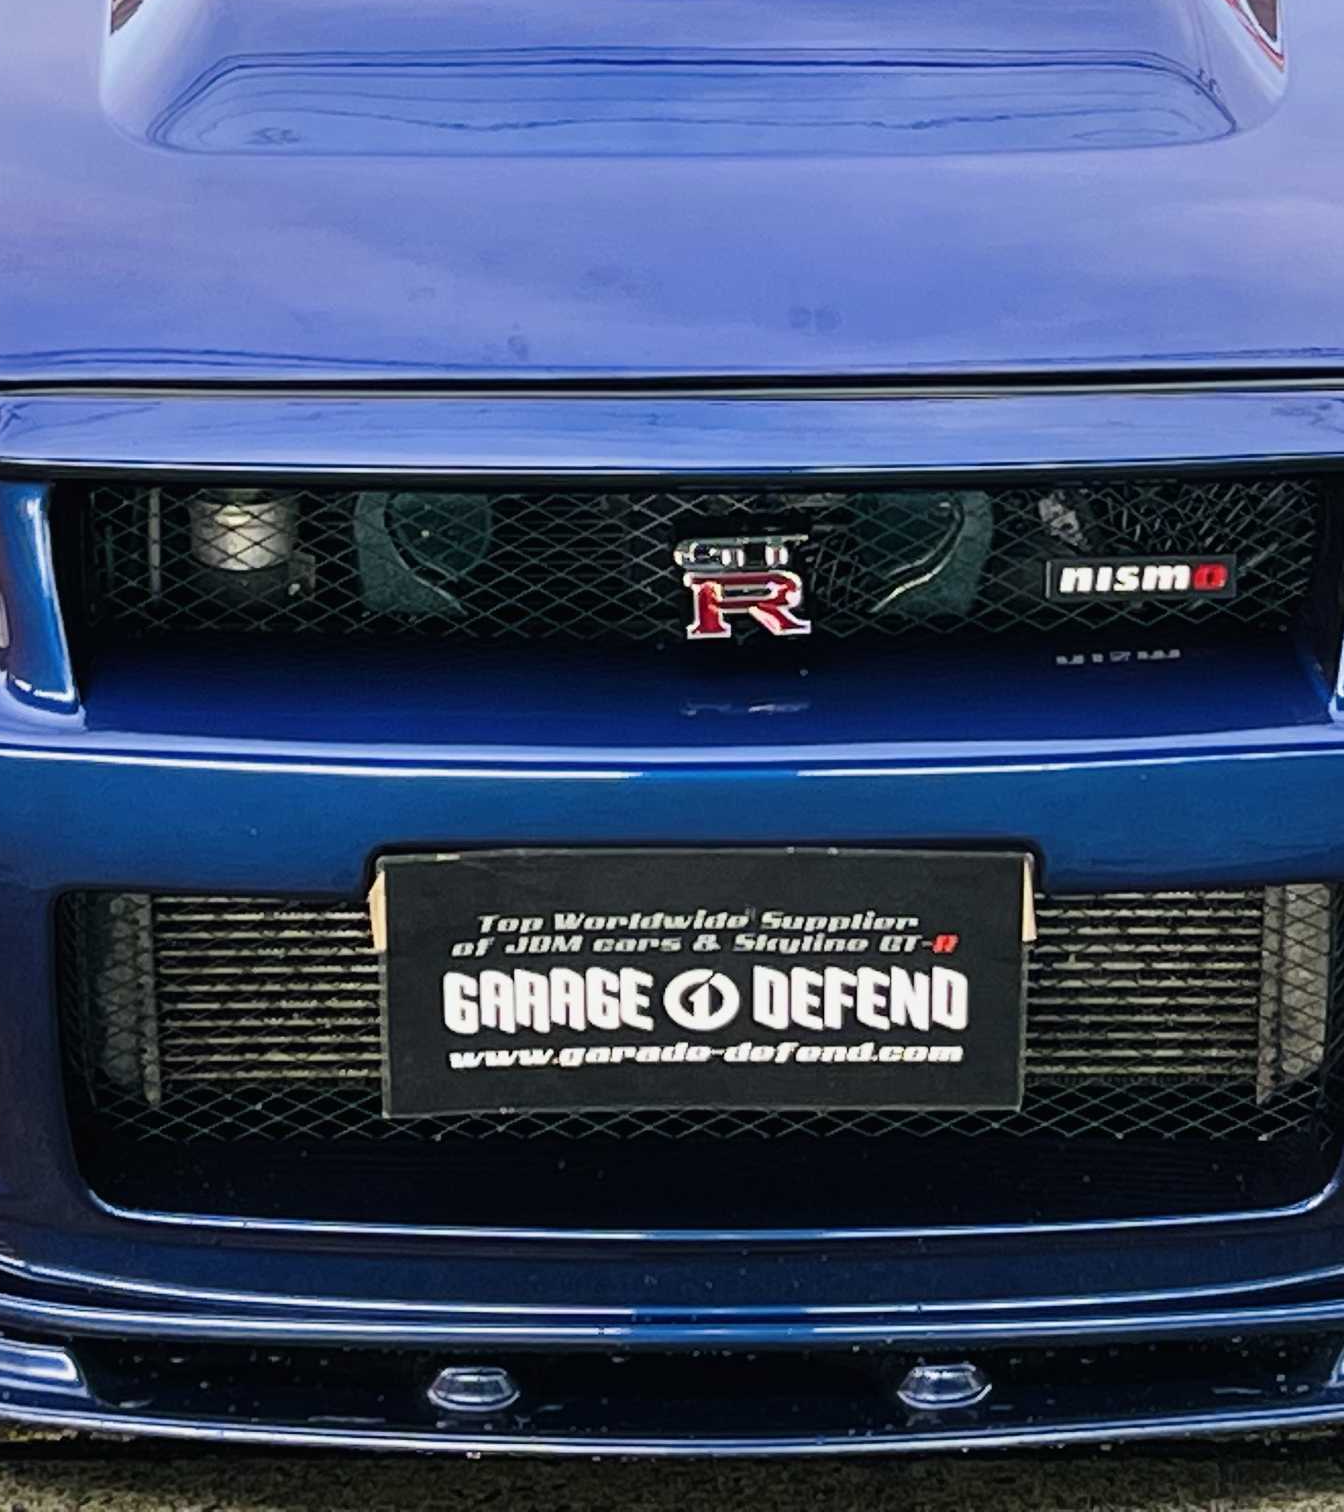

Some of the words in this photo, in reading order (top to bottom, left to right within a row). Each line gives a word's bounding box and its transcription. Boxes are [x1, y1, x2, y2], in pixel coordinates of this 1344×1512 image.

[1059, 563, 1228, 593] nismo
[683, 570, 811, 639] R
[478, 914, 544, 934] Top
[553, 909, 749, 931] Worldwide
[761, 911, 919, 932] Supplier
[451, 936, 494, 957] of
[504, 934, 584, 954] JDM
[592, 937, 682, 953] cars
[692, 935, 721, 953] &
[733, 933, 869, 954] Skyline
[879, 934, 959, 954] GT-R
[443, 966, 655, 1035] GARAGE
[752, 965, 969, 1031] DEFEND
